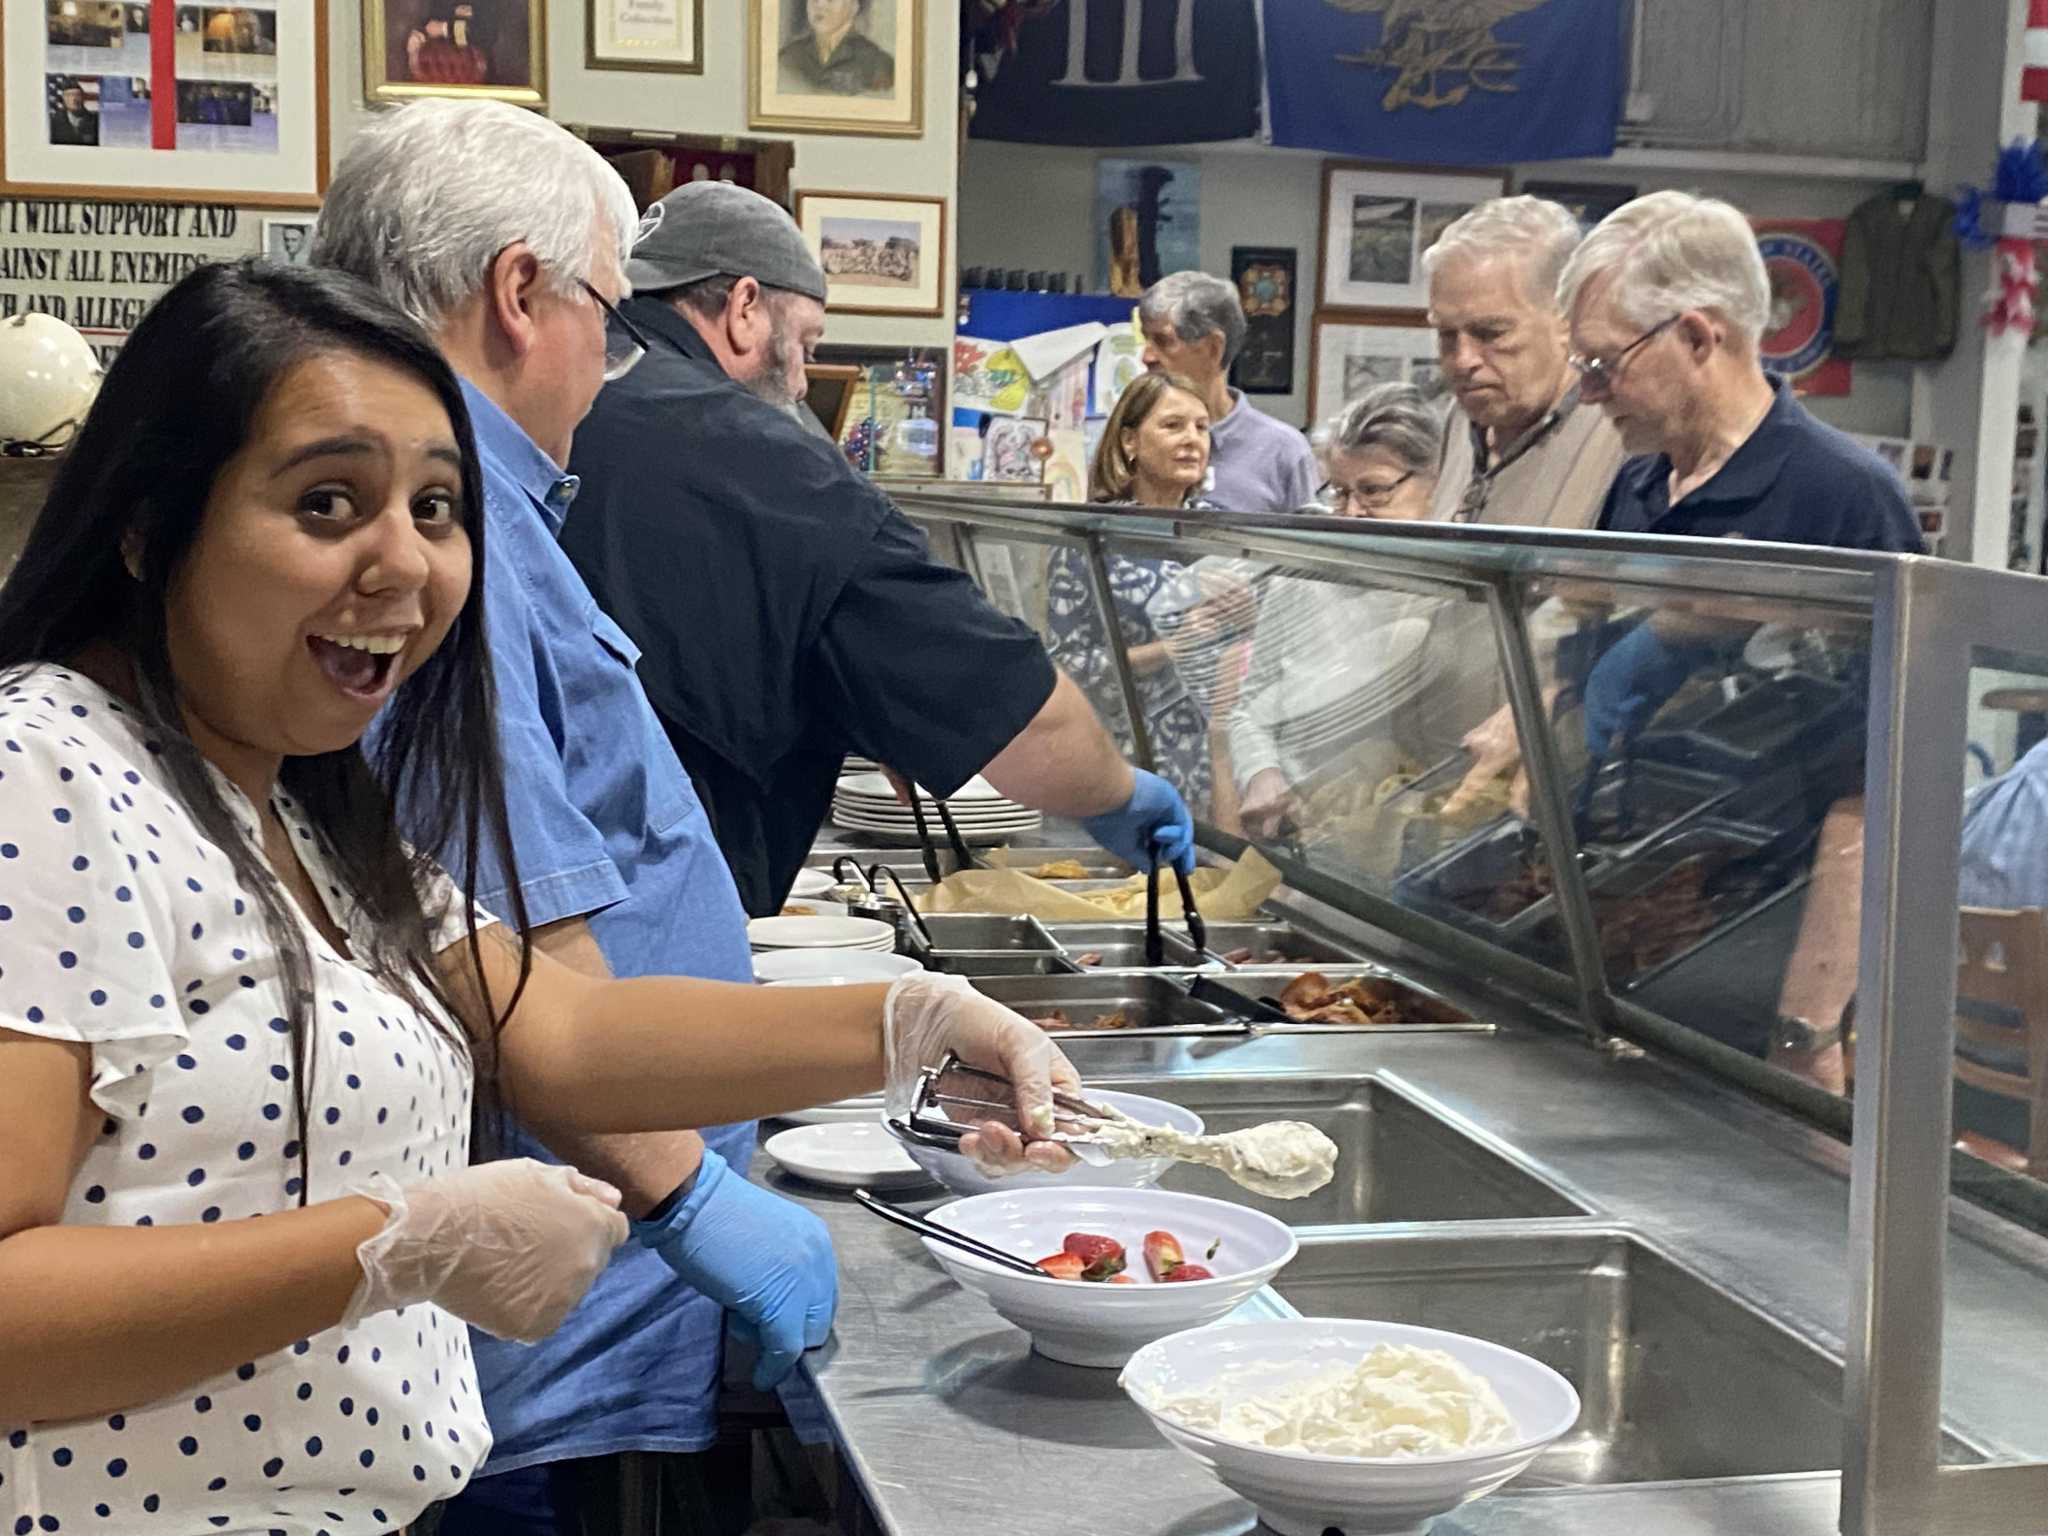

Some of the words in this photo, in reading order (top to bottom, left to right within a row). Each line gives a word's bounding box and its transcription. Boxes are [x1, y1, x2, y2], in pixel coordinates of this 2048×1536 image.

[10, 200, 18, 233] I
[25, 200, 75, 234] WILL
[80, 202, 183, 238] SUPPORT
[188, 204, 236, 238] AND
[65, 250, 105, 282] ALL
